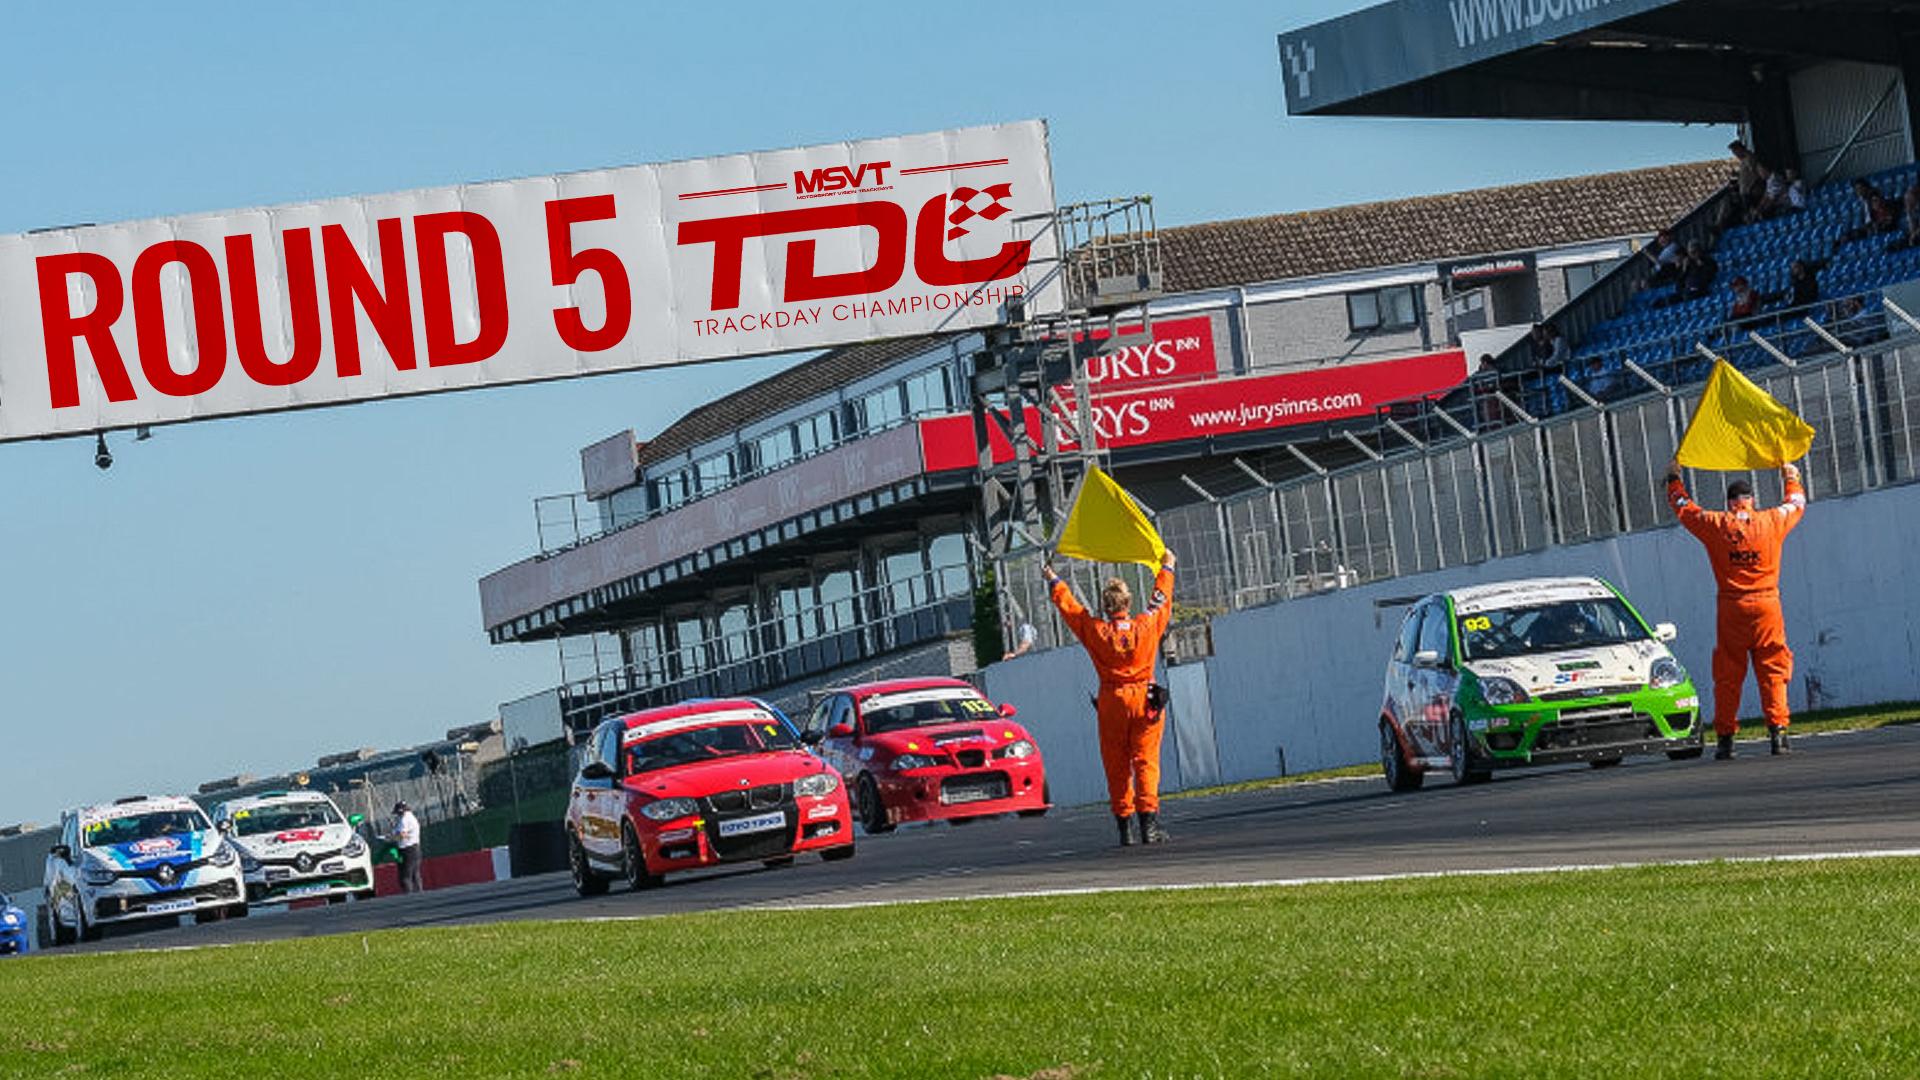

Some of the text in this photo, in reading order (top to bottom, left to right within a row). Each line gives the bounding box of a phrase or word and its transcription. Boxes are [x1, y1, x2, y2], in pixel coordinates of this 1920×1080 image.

[1450, 0, 1622, 48] WWW.D
[794, 161, 891, 194] MSVT
[677, 183, 1031, 311] TDC
[36, 194, 632, 409] ROUND 5
[694, 285, 1024, 337] TRACKDAY CHAMPIONSHIP
[1175, 337, 1200, 350] INN
[1149, 397, 1175, 411] INN
[1190, 393, 1362, 426] www.jurysinns.com
[1464, 616, 1491, 632] 93
[960, 700, 995, 713] 113
[764, 725, 777, 736] 1
